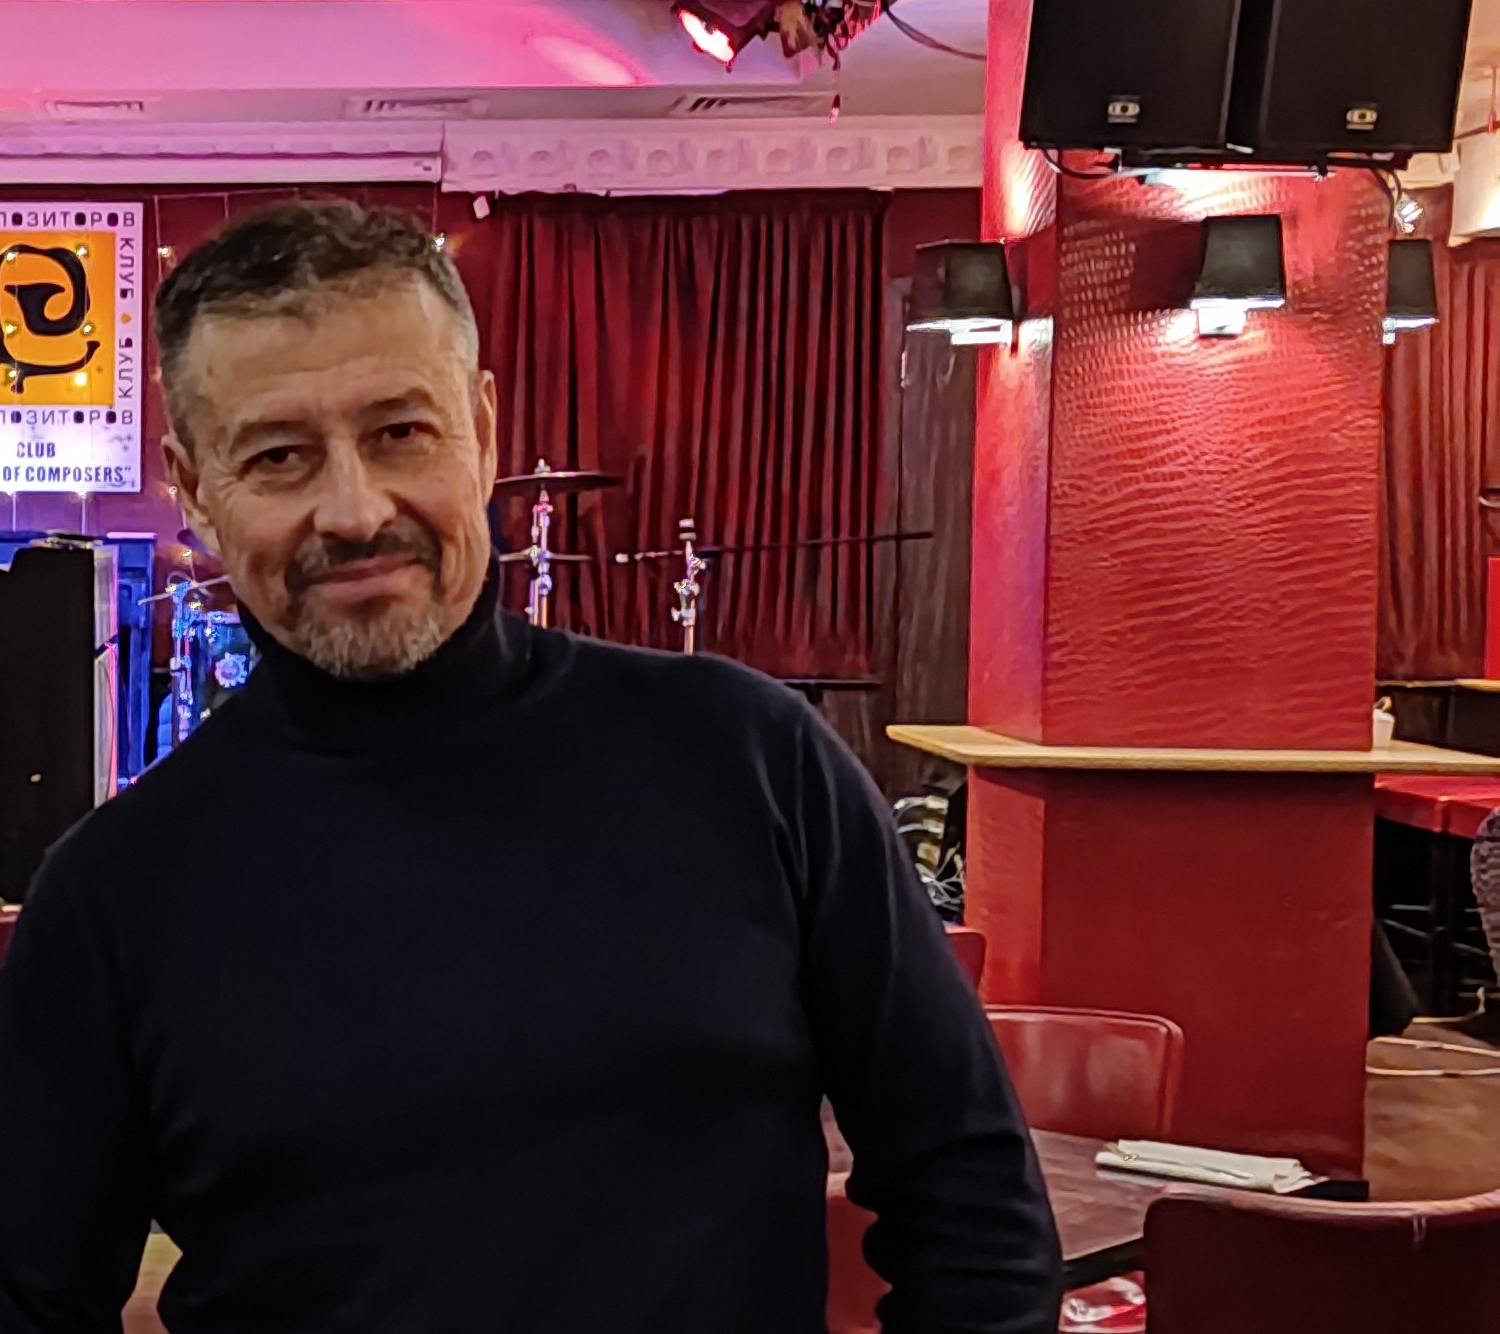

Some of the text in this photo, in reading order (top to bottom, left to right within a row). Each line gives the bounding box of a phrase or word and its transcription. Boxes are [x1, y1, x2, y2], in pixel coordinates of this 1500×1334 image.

[119, 237, 135, 300] КЛУБ
[118, 337, 134, 399] КЛУБ
[16, 441, 56, 458] CLUB
[2, 465, 21, 482] OF
